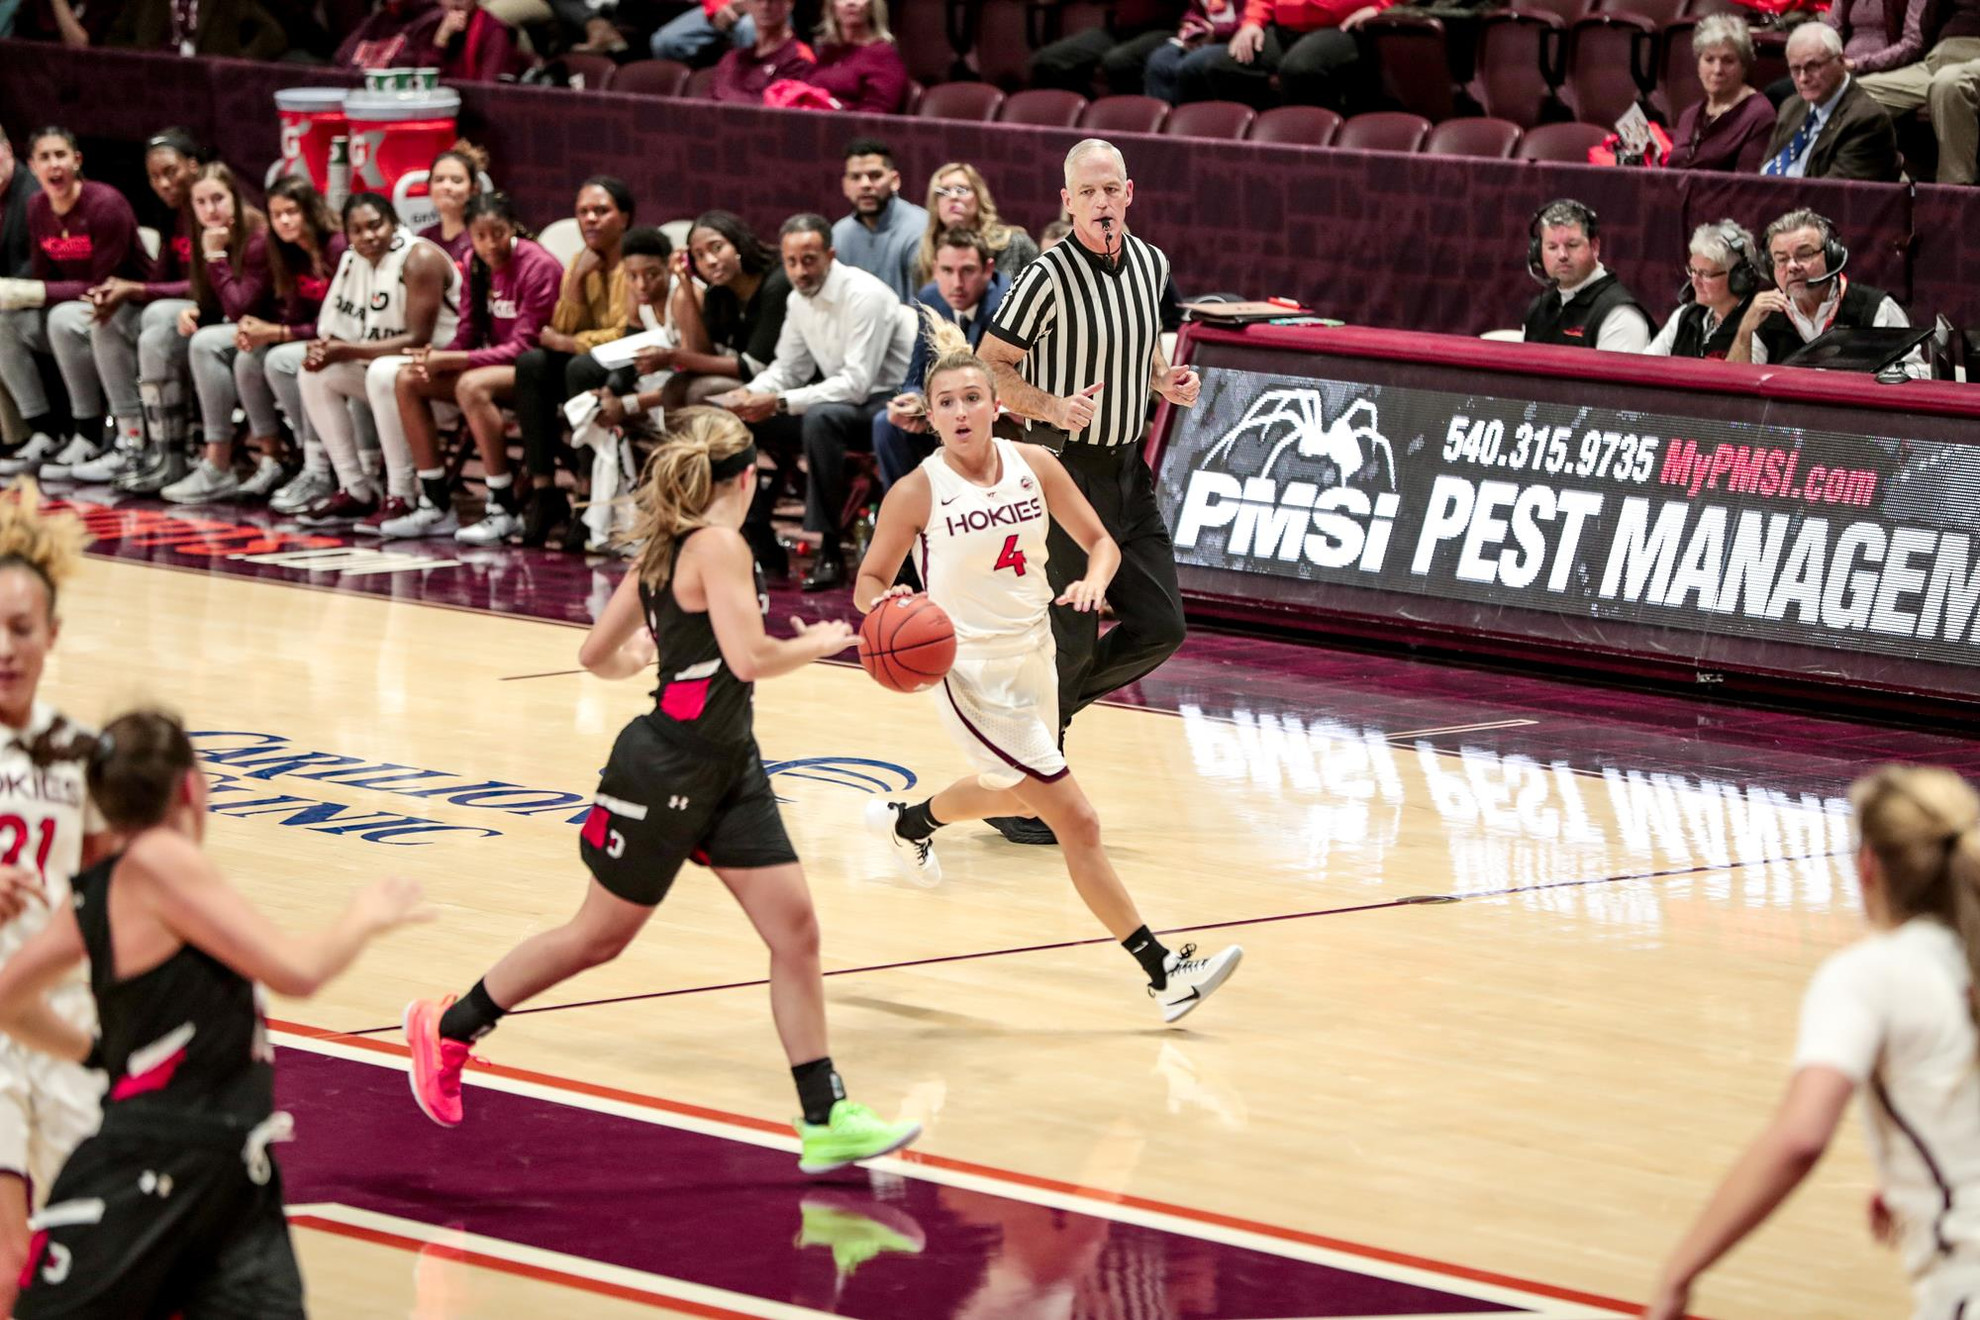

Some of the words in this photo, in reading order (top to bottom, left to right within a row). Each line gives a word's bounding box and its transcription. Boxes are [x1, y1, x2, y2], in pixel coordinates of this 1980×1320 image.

[1443, 415, 1659, 484] 540.315.9735
[946, 498, 1042, 536] HOKIES
[1411, 474, 1604, 594] PEST
[993, 534, 1027, 577] 4
[184, 731, 594, 824] CARILIO
